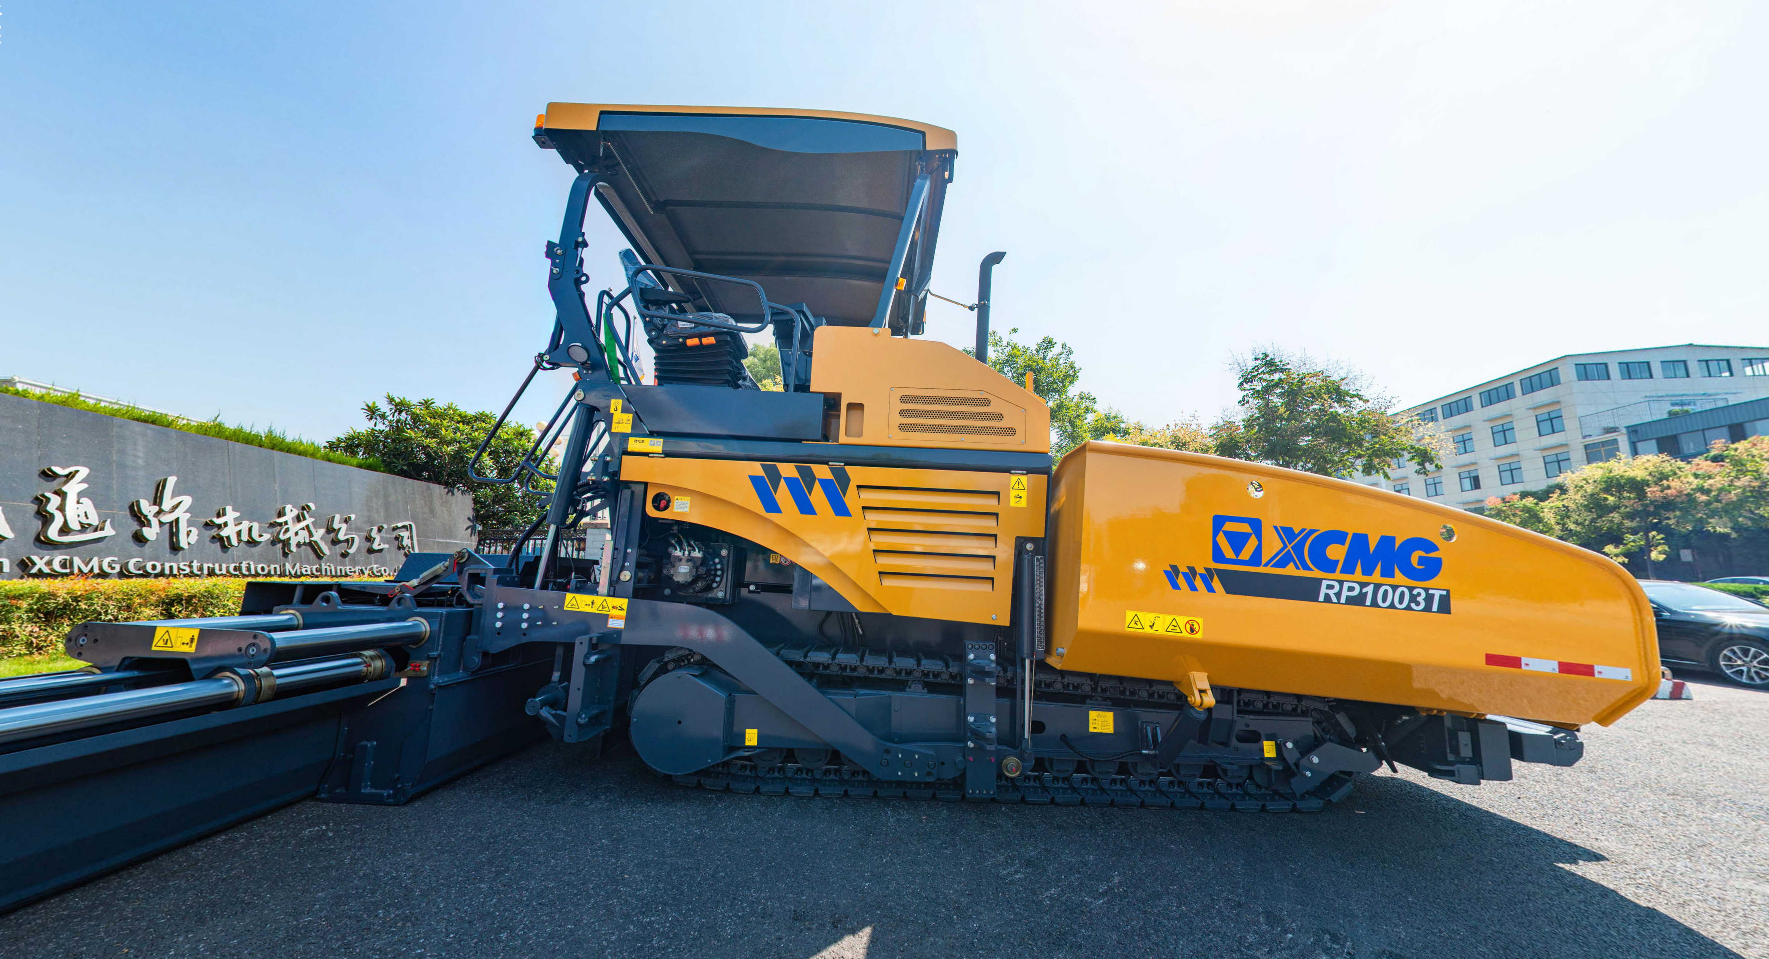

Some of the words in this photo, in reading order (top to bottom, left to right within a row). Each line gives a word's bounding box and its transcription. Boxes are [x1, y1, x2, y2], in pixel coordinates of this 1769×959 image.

[29, 555, 121, 575] XCMG
[127, 557, 281, 576] Construction
[283, 561, 368, 579] Machinery
[1262, 525, 1443, 582] XCMG
[1318, 579, 1447, 612] RP1003T
